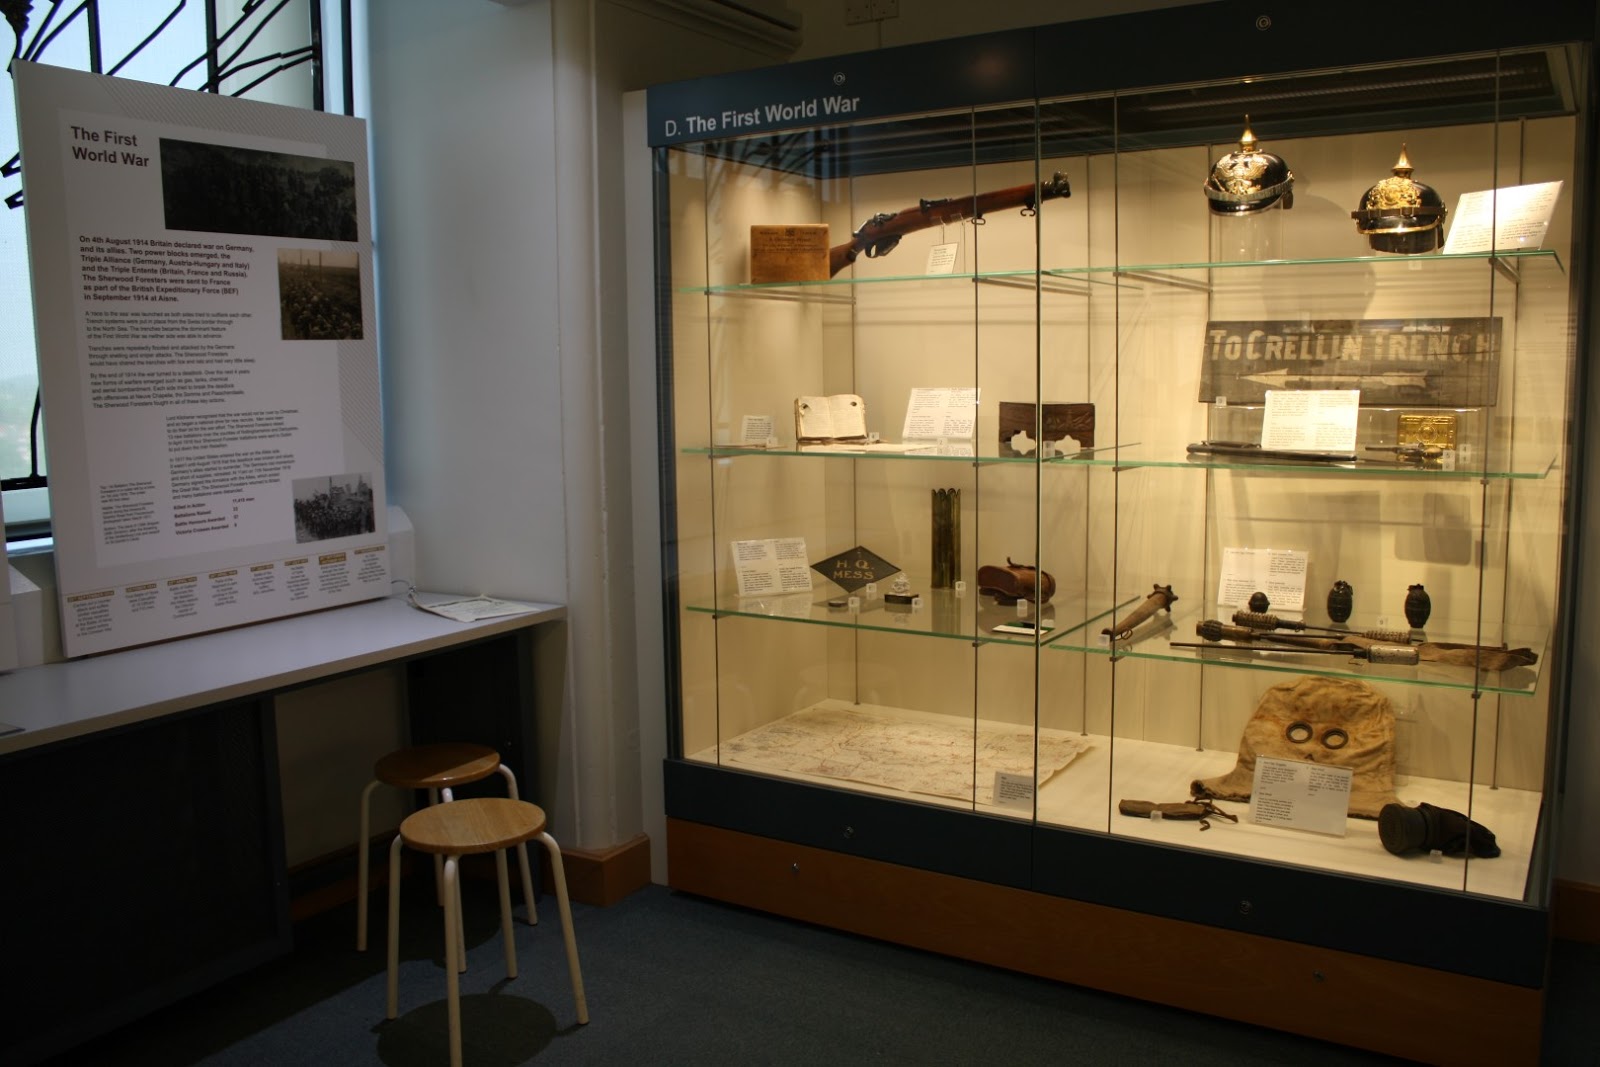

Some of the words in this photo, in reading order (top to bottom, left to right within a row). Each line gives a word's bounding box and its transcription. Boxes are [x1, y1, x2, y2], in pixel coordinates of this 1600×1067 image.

[665, 120, 681, 137] D.
[686, 116, 716, 134] The
[722, 108, 760, 129] First
[765, 99, 817, 122] World
[823, 96, 860, 115] War
[71, 125, 99, 141] The
[104, 130, 137, 146] First
[72, 146, 117, 163] World
[121, 152, 149, 166] War
[169, 260, 220, 268] Austria-Hungary
[156, 286, 200, 294] Expeditionary
[1246, 329, 1362, 360] CRELLIN
[1370, 329, 1496, 362] TRENCH
[833, 570, 874, 579] MESS
